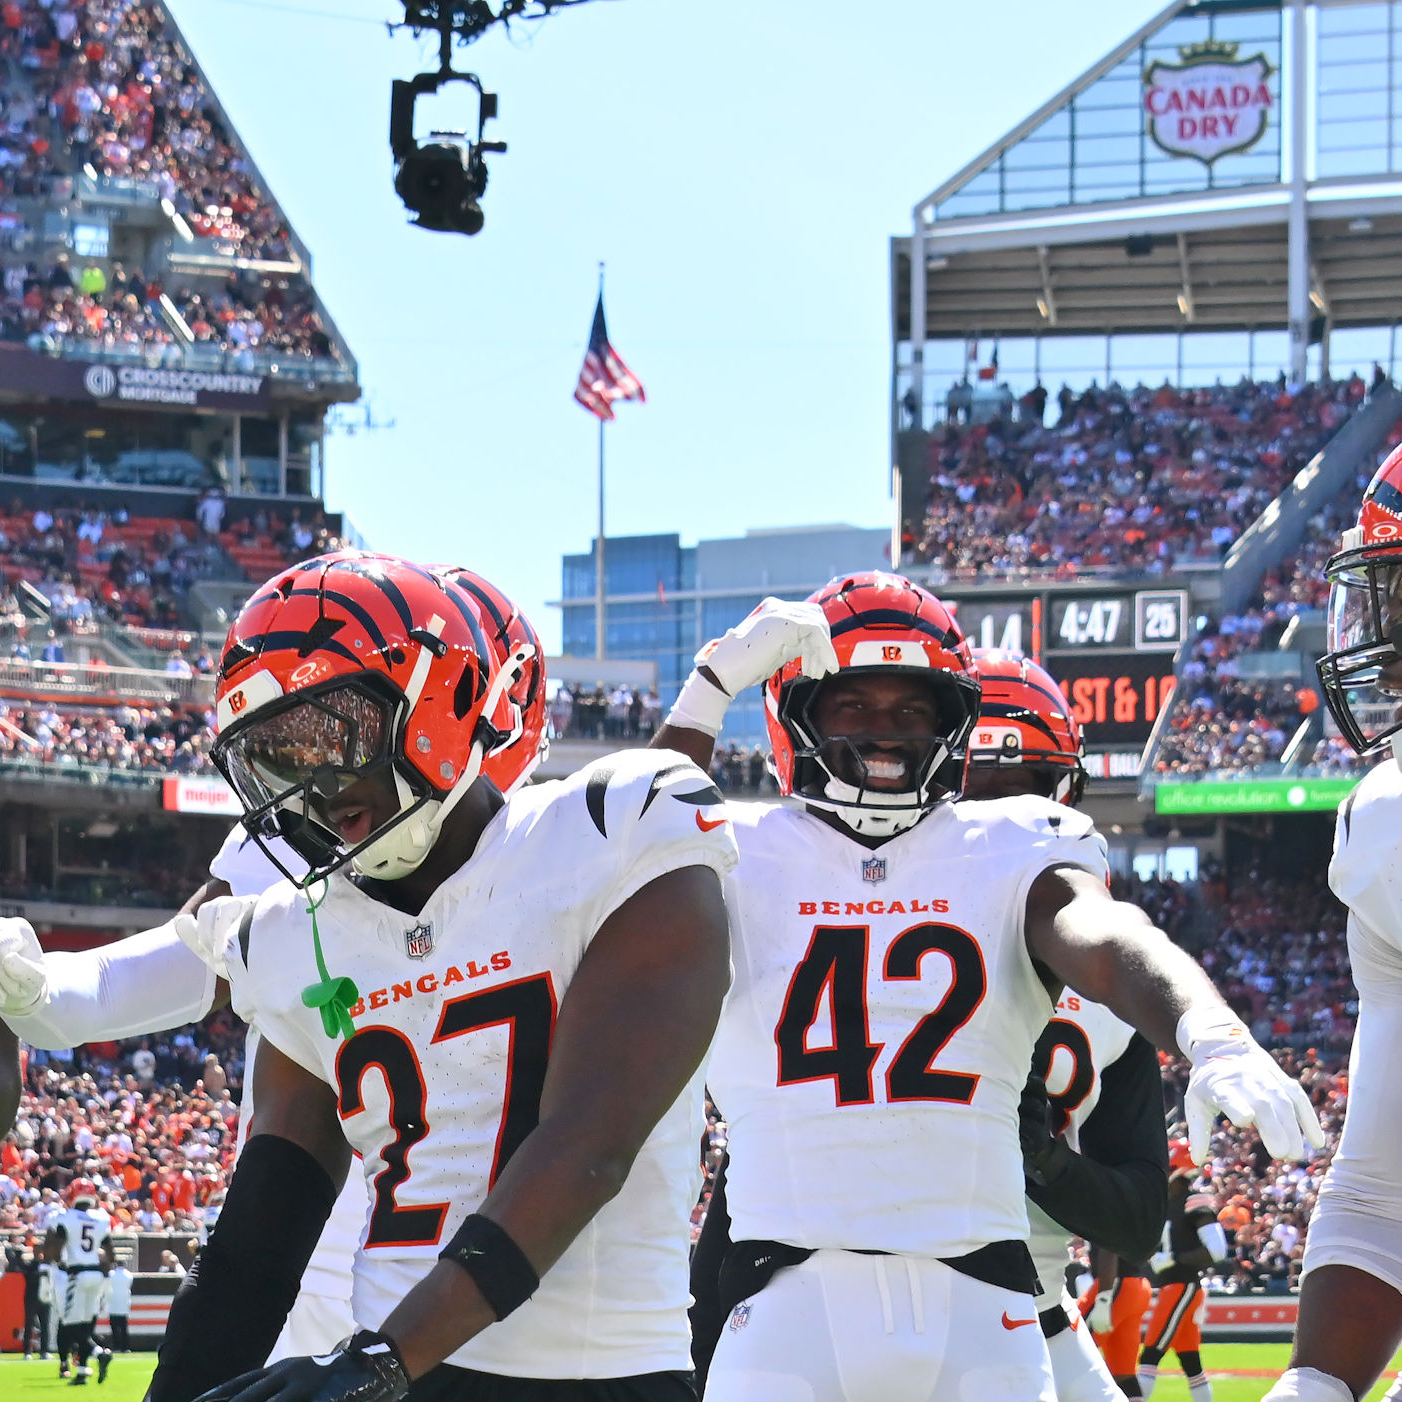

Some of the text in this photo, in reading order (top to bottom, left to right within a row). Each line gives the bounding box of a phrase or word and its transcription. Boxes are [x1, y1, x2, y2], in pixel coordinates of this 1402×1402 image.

[1144, 83, 1273, 116] CANADA
[1178, 113, 1238, 140] DRY
[118, 366, 263, 394] CROSSCOUNTRY
[1060, 601, 1121, 644] 4:47
[1145, 602, 1176, 638] 25
[798, 898, 951, 915] BENGALS
[349, 951, 512, 1019] BENGALS
[775, 921, 987, 1108] 42
[335, 970, 558, 1250] 27
[81, 1225, 95, 1253] 5
